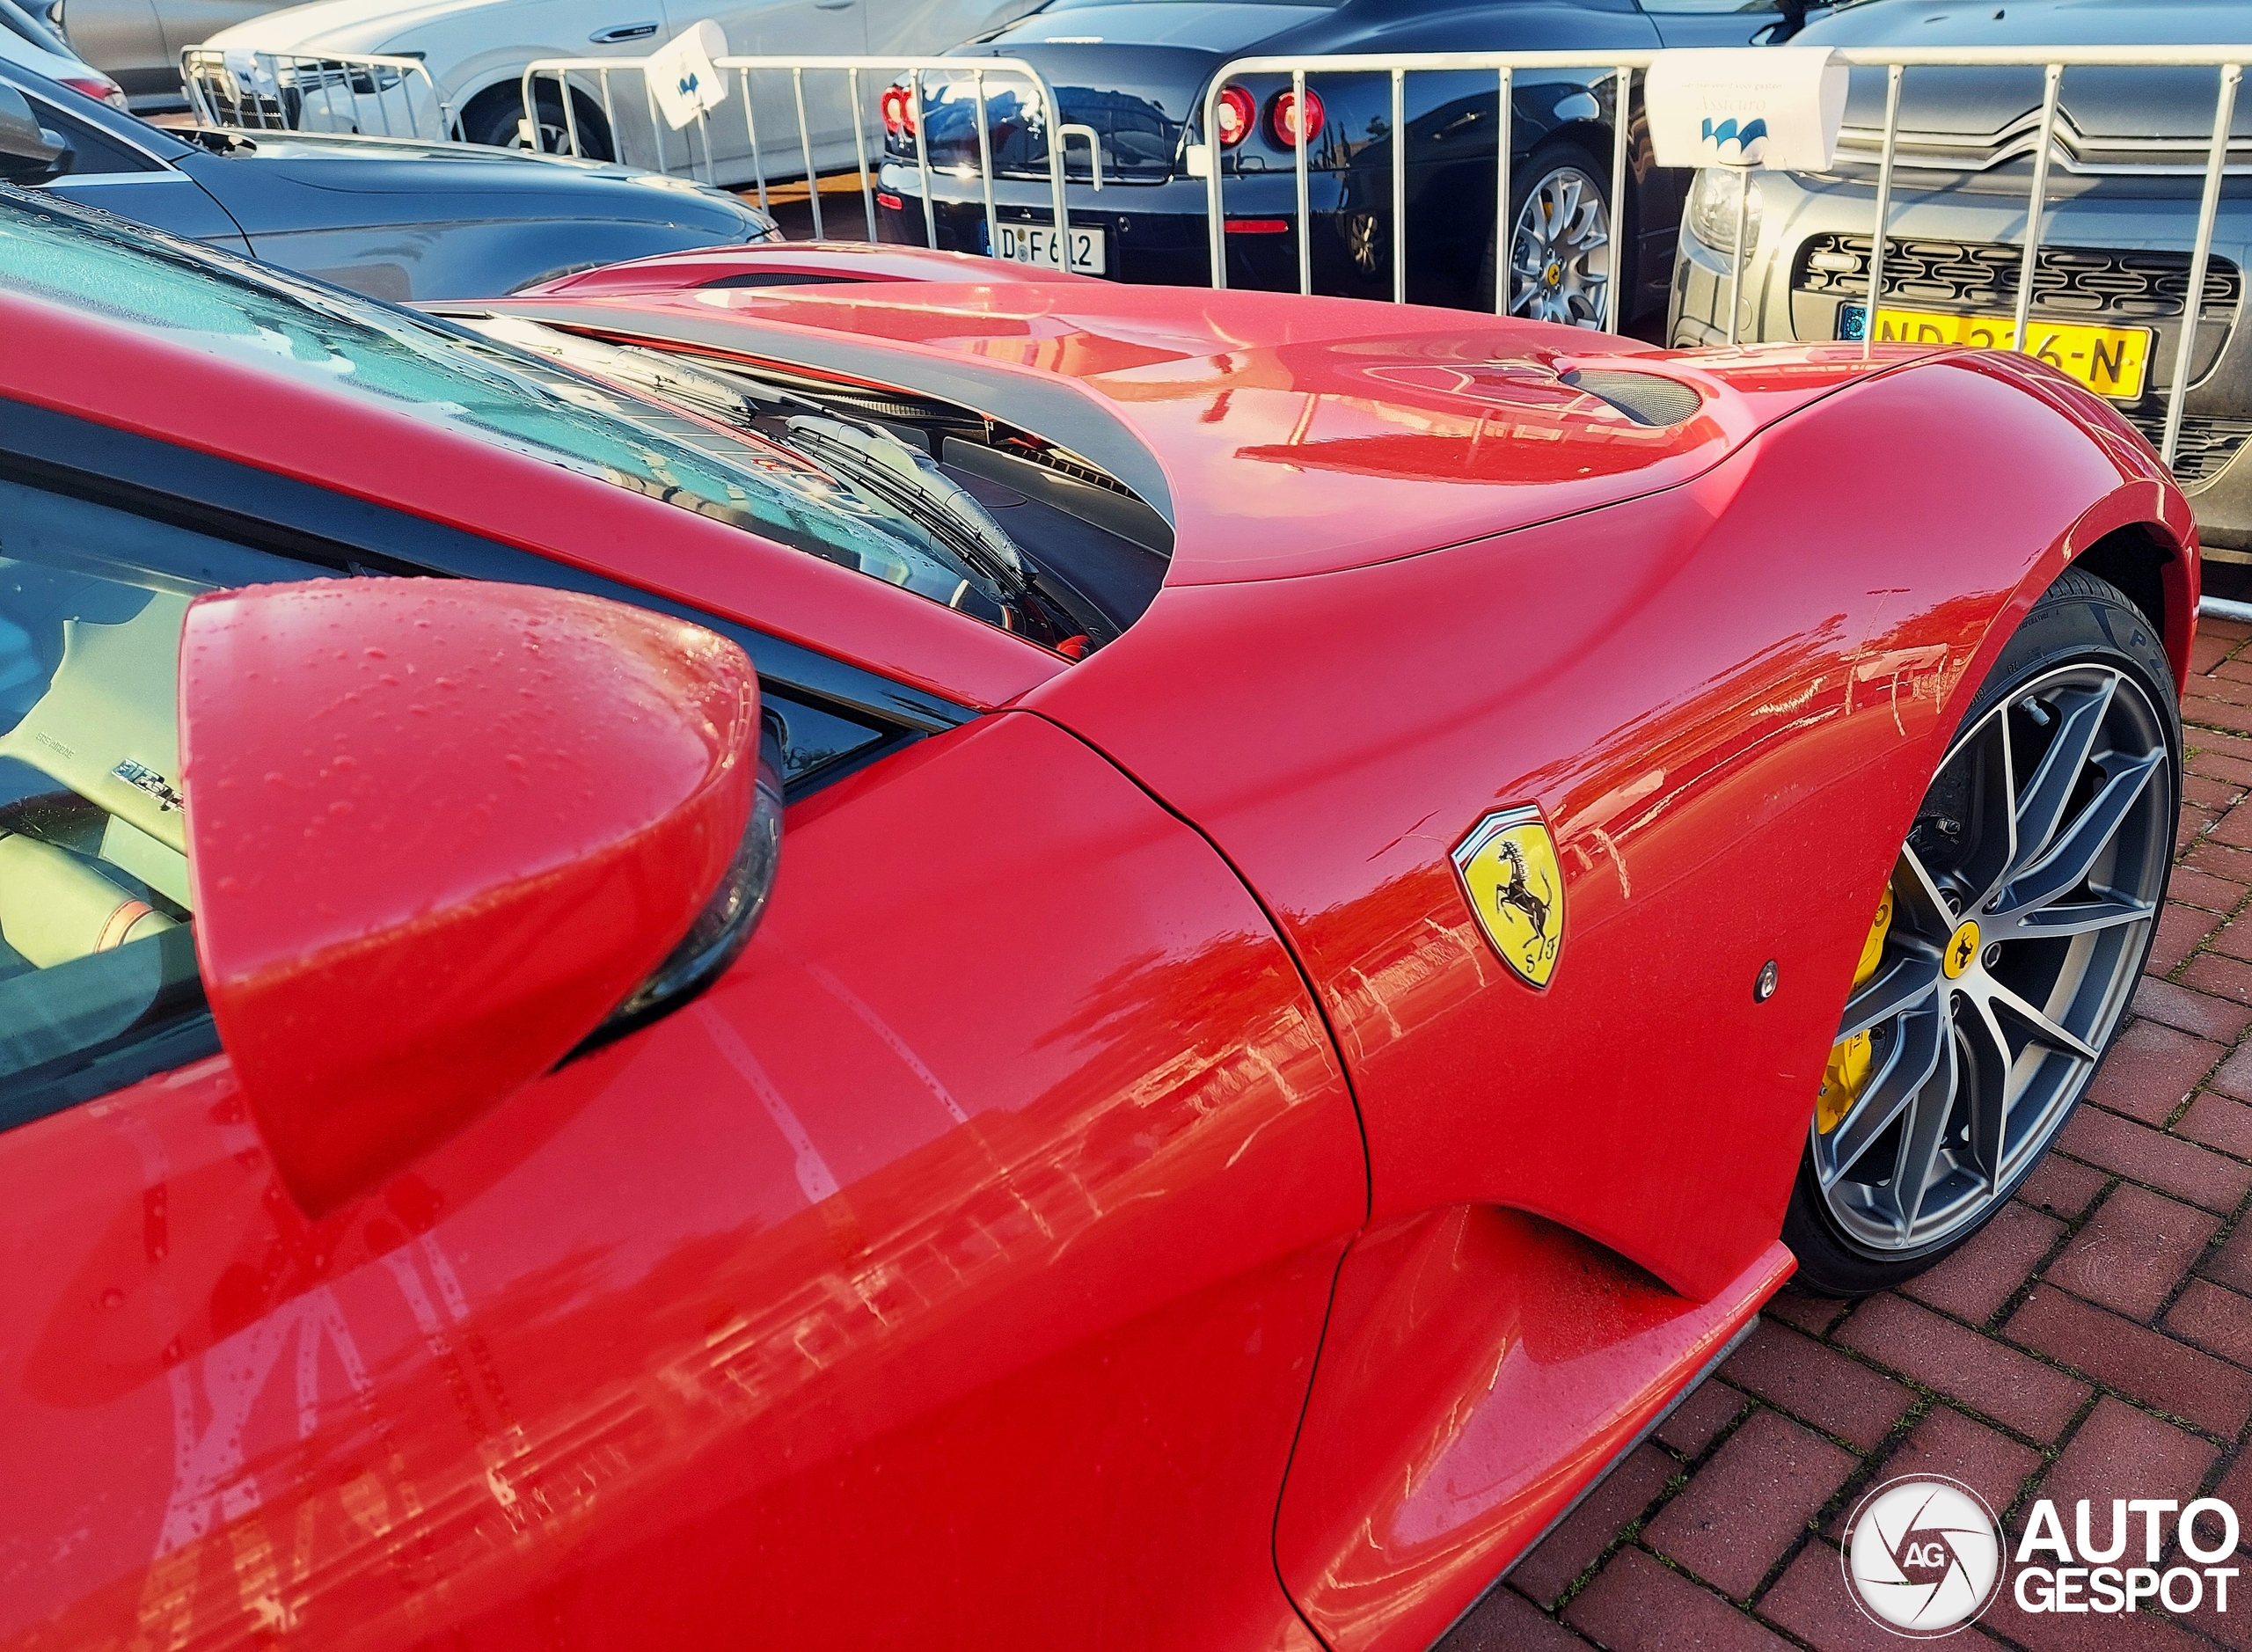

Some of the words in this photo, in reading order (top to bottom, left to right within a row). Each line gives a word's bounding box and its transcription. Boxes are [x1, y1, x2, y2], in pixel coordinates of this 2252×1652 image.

[1754, 82, 1782, 91] gasten
[1697, 94, 1766, 112] Assicuro
[1002, 229, 1015, 259] D
[1030, 231, 1042, 261] F
[1525, 954, 1536, 974] S
